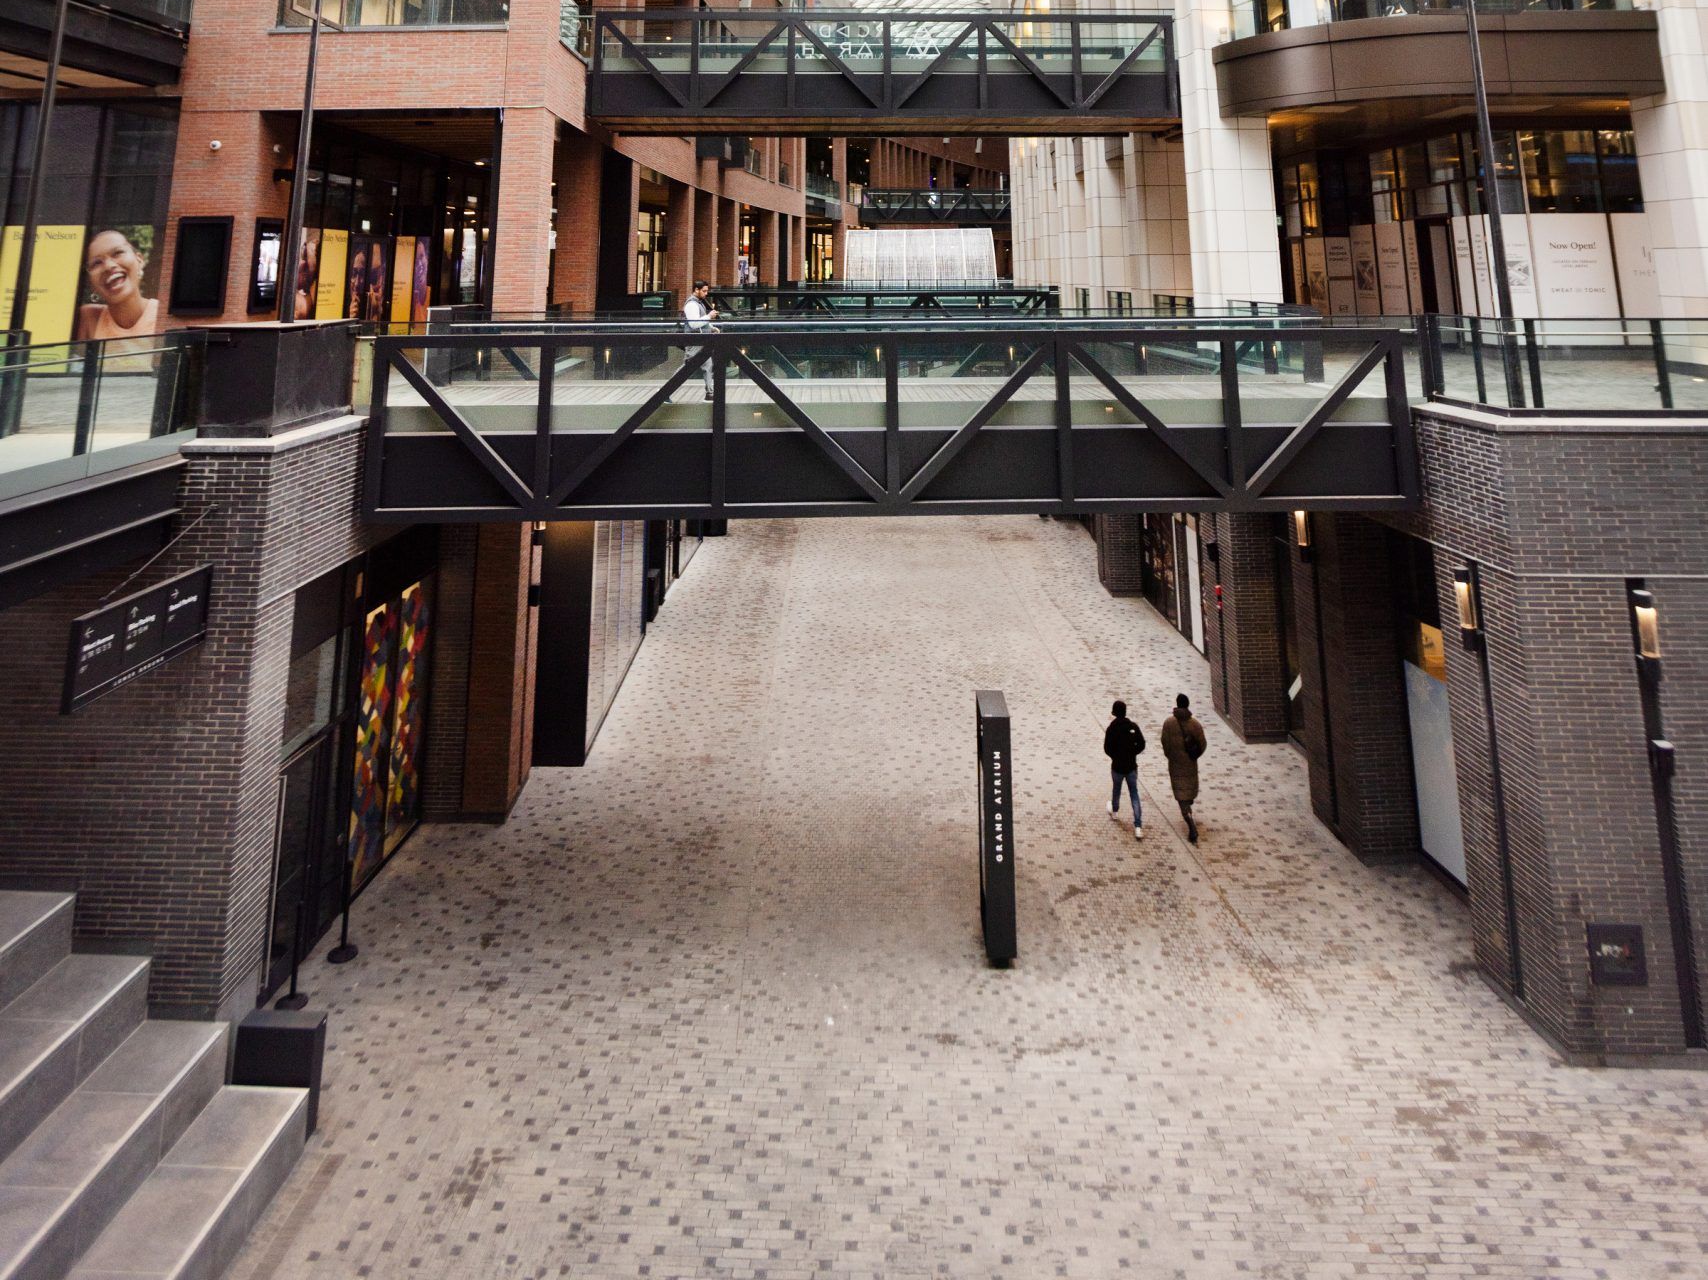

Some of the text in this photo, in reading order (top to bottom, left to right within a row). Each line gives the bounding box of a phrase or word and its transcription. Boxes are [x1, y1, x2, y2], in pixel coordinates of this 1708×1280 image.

[1549, 241, 1597, 252] Now Open!
[993, 751, 1003, 862] GRAND ATRIUM
